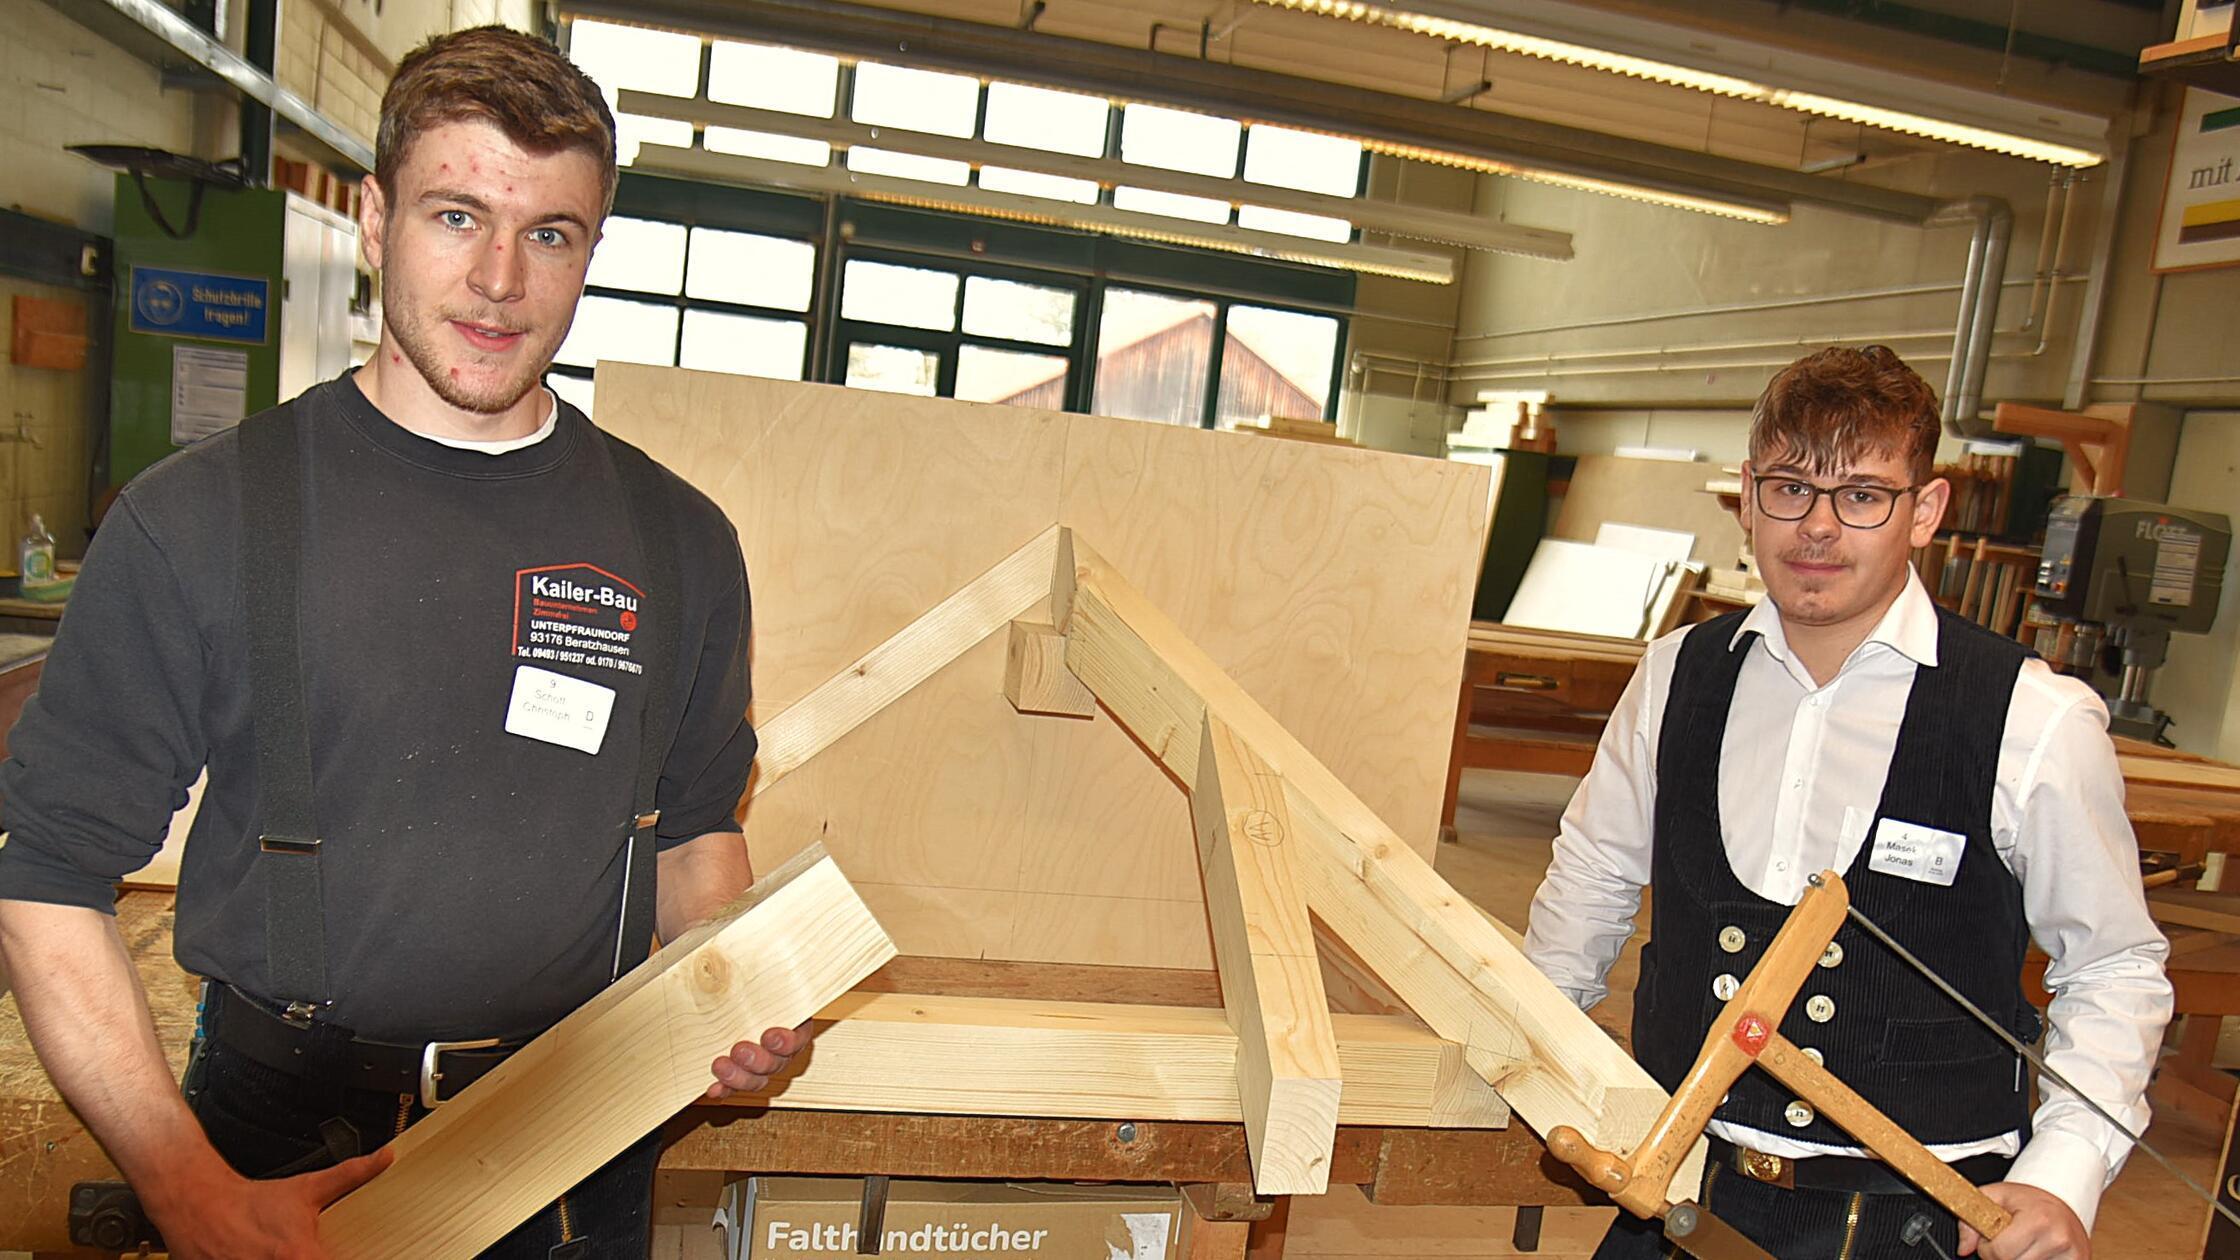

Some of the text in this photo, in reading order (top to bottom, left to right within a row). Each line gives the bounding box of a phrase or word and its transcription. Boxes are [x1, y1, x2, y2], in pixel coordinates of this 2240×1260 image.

[2187, 157, 2232, 190] mit
[191, 285, 263, 310] Schutzbrille
[532, 575, 638, 612] Kailer-Bau
[531, 619, 631, 643] UNTERPFRAUNDORF
[517, 646, 531, 657] Tel.
[530, 632, 630, 656] 93176 Beratzhausen
[585, 710, 594, 722] D
[1884, 854, 1913, 867] Jonas
[1934, 856, 1944, 866] B
[766, 1221, 1048, 1252] Falthndtücher
